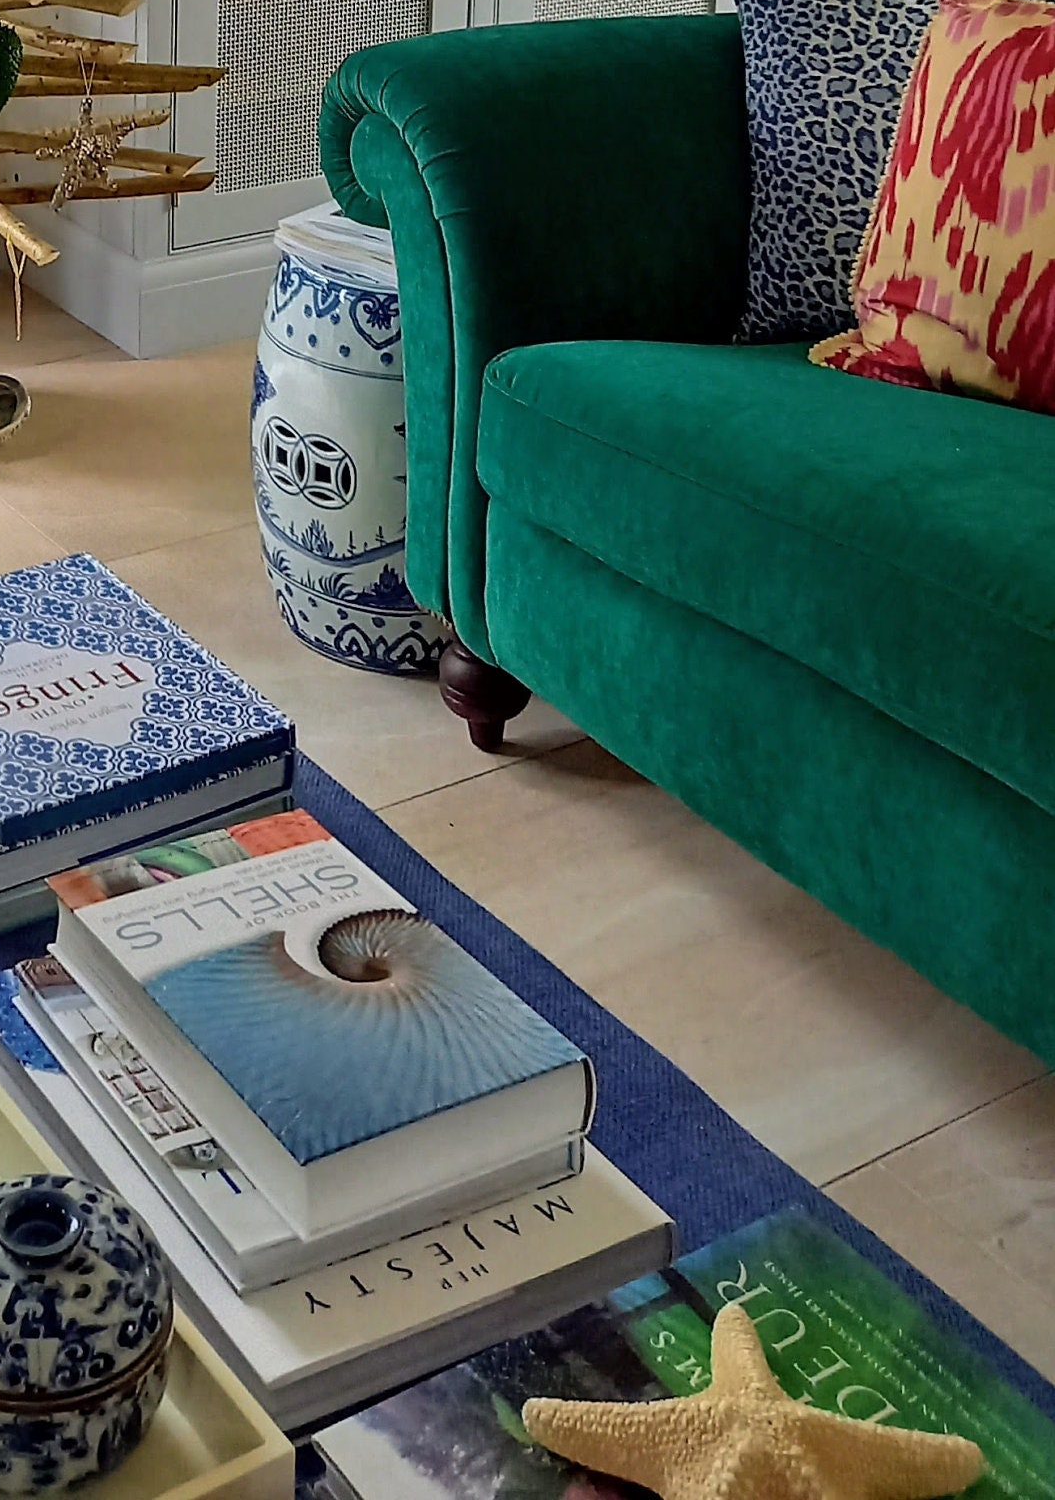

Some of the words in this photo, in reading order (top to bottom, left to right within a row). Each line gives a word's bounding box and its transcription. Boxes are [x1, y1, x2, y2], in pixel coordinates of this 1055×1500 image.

[61, 699, 87, 711] ON
[115, 864, 359, 950] SHELLS
[331, 890, 361, 904] THE
[274, 901, 321, 918] BOOK
[246, 916, 266, 929] OF
[304, 1195, 574, 1315] MAJESTY
[440, 1263, 490, 1290] HER
[716, 1260, 899, 1423] DEUR
